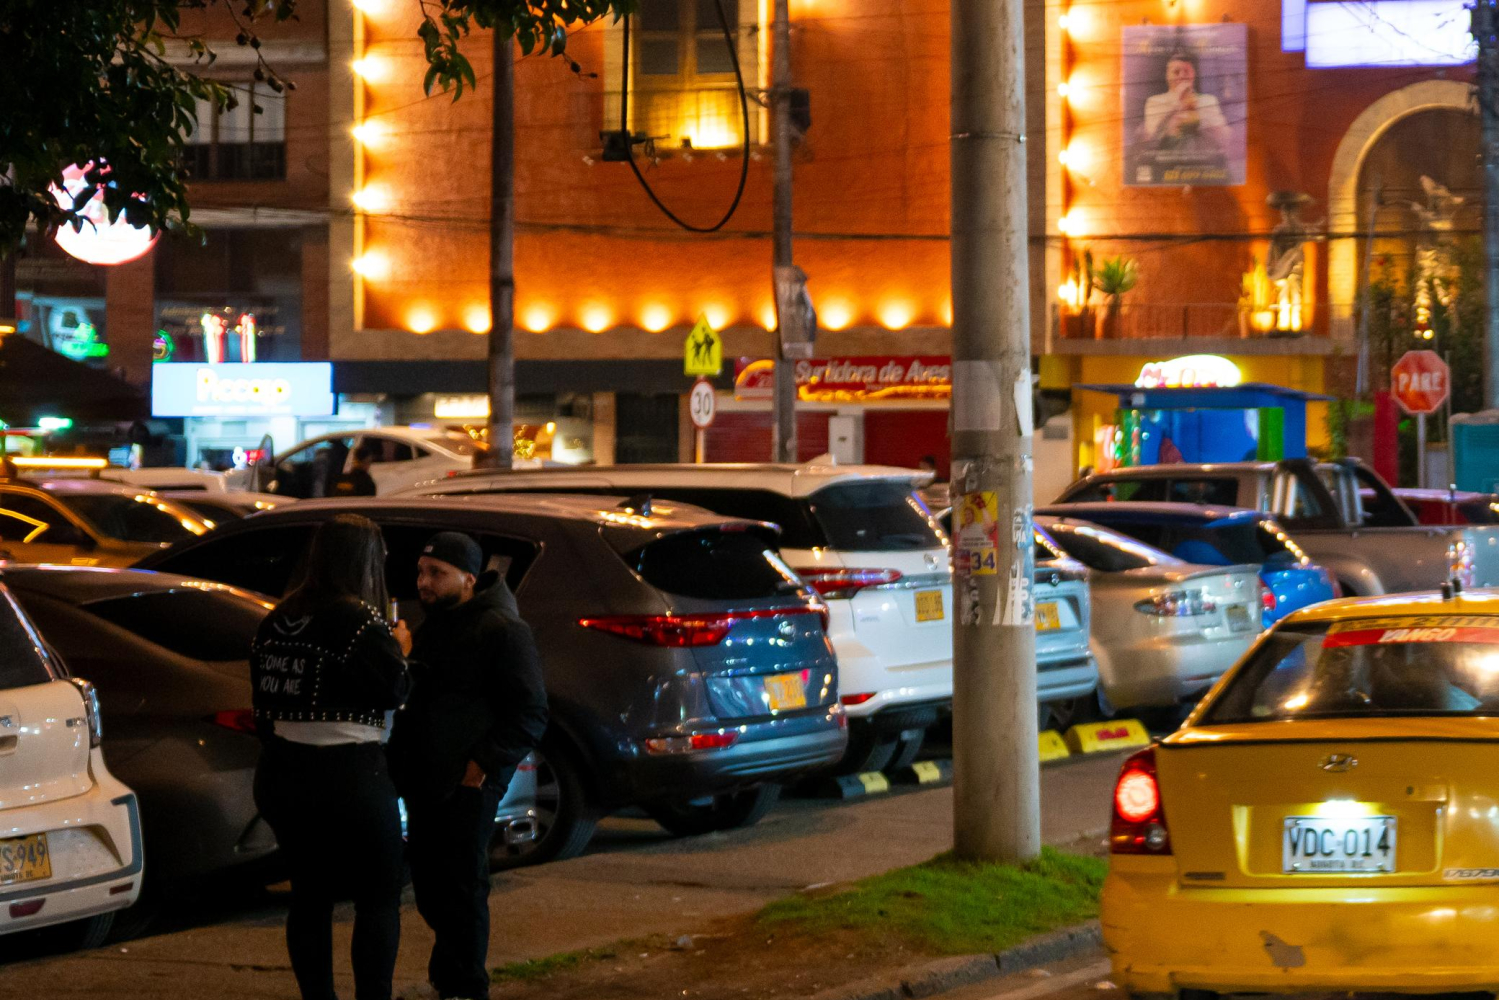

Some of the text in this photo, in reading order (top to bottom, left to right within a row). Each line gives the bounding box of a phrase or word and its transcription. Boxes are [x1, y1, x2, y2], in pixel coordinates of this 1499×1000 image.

[796, 360, 877, 383] Surtidora
[878, 361, 904, 382] de
[1399, 372, 1441, 392] PARE
[693, 391, 711, 415] 30
[971, 552, 995, 570] 34
[291, 658, 306, 675] AS
[259, 675, 302, 696] YOU ARE
